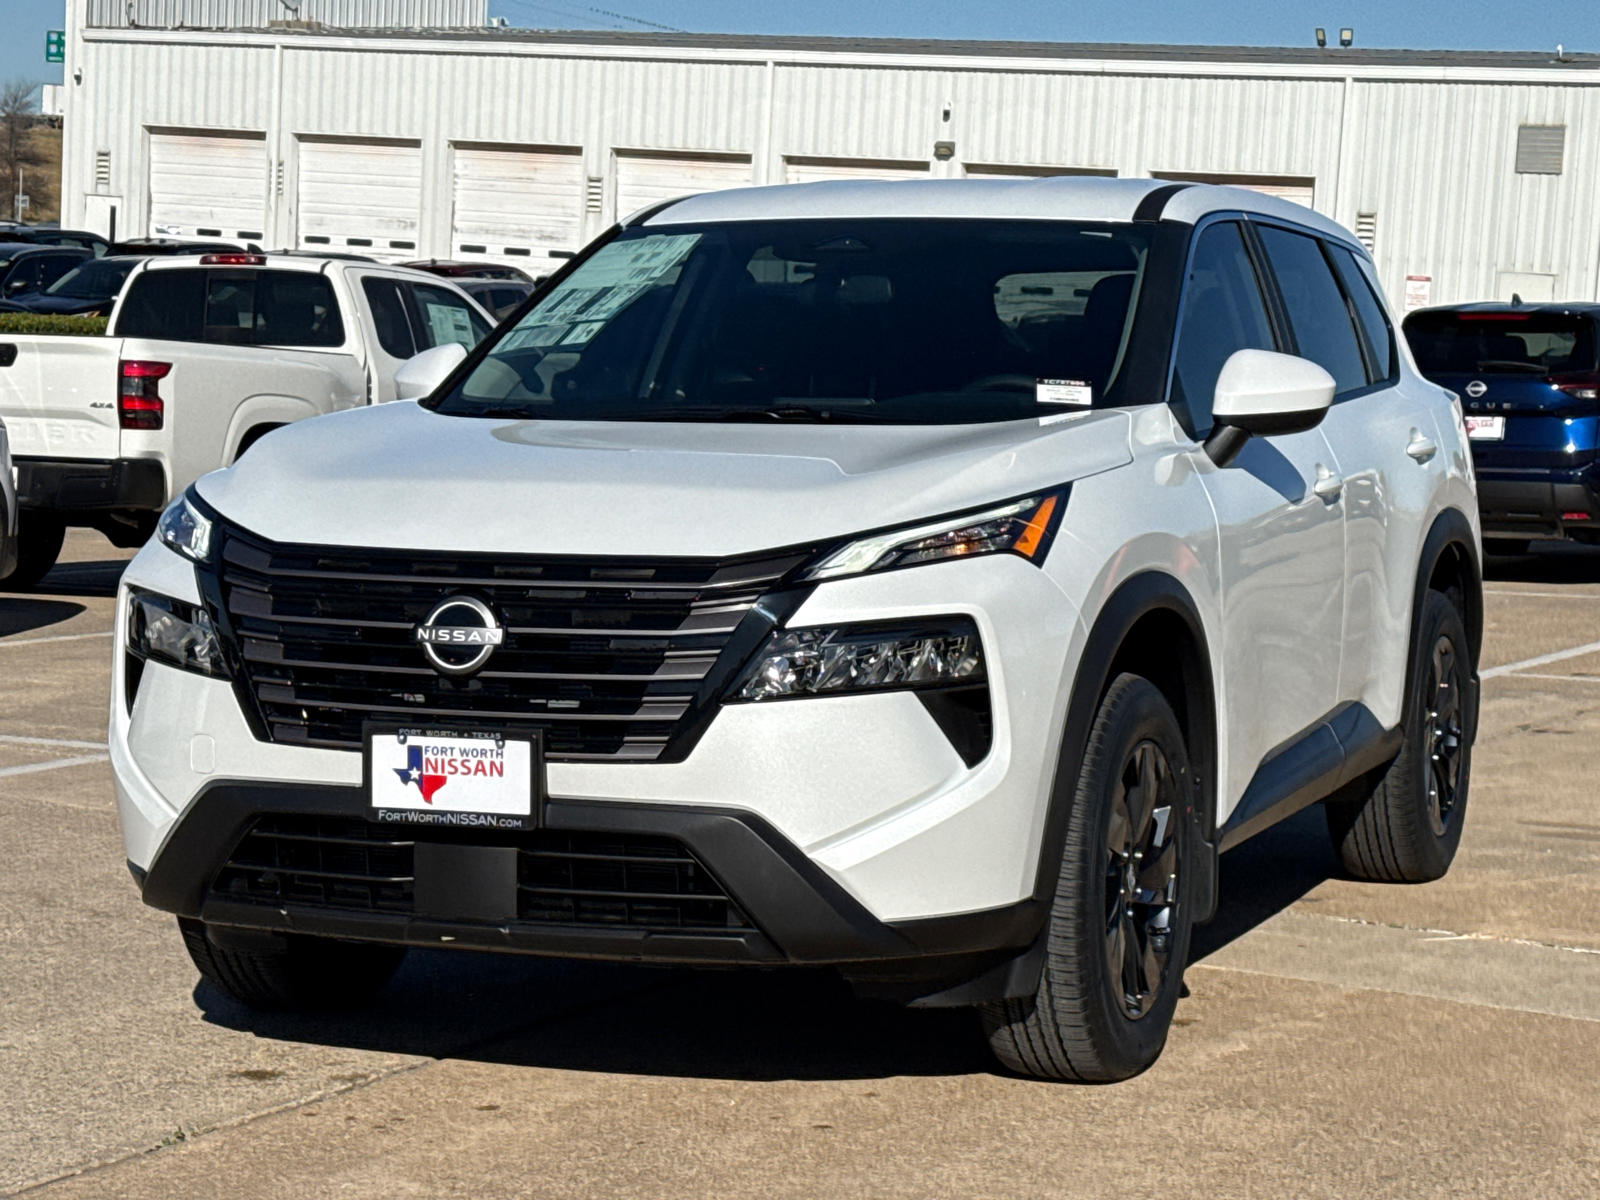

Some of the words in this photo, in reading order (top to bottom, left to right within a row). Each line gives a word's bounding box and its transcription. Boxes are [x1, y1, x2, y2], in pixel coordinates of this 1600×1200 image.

[417, 627, 500, 643] NISSAN
[399, 729, 422, 737] FORT
[426, 730, 458, 738] WORTH
[471, 731, 501, 740] TEXAS
[424, 746, 456, 757] FORT
[459, 747, 504, 759] WORTH
[424, 757, 504, 778] NISSAN
